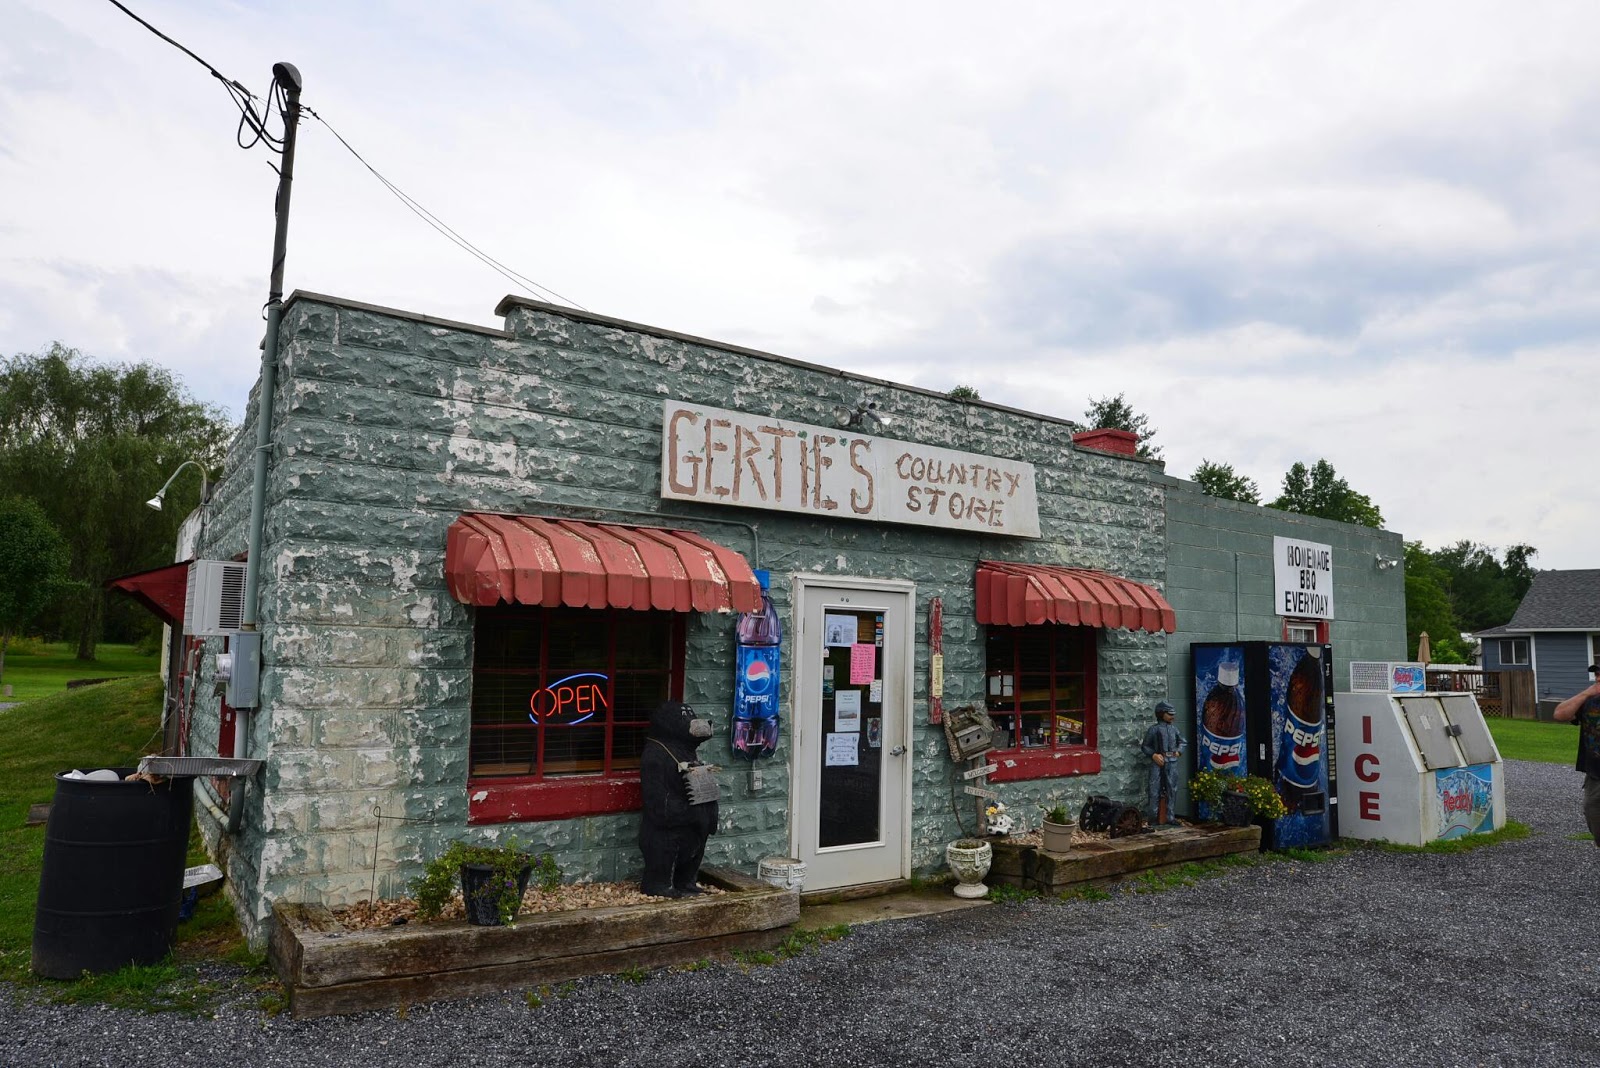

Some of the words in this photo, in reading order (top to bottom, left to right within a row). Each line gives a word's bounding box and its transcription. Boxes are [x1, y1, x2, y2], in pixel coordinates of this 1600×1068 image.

[668, 408, 874, 516] GERTIE'S
[896, 452, 1021, 498] COUNTRY
[905, 486, 1005, 527] STORE
[1287, 545, 1330, 572] HOMEMADE
[1300, 569, 1316, 591] BBQ
[1285, 590, 1329, 616] EVERYDAY
[530, 684, 608, 717] OPEN
[744, 694, 770, 703] PEPSI
[1284, 718, 1321, 748] PEPS
[1354, 715, 1381, 821] ICE
